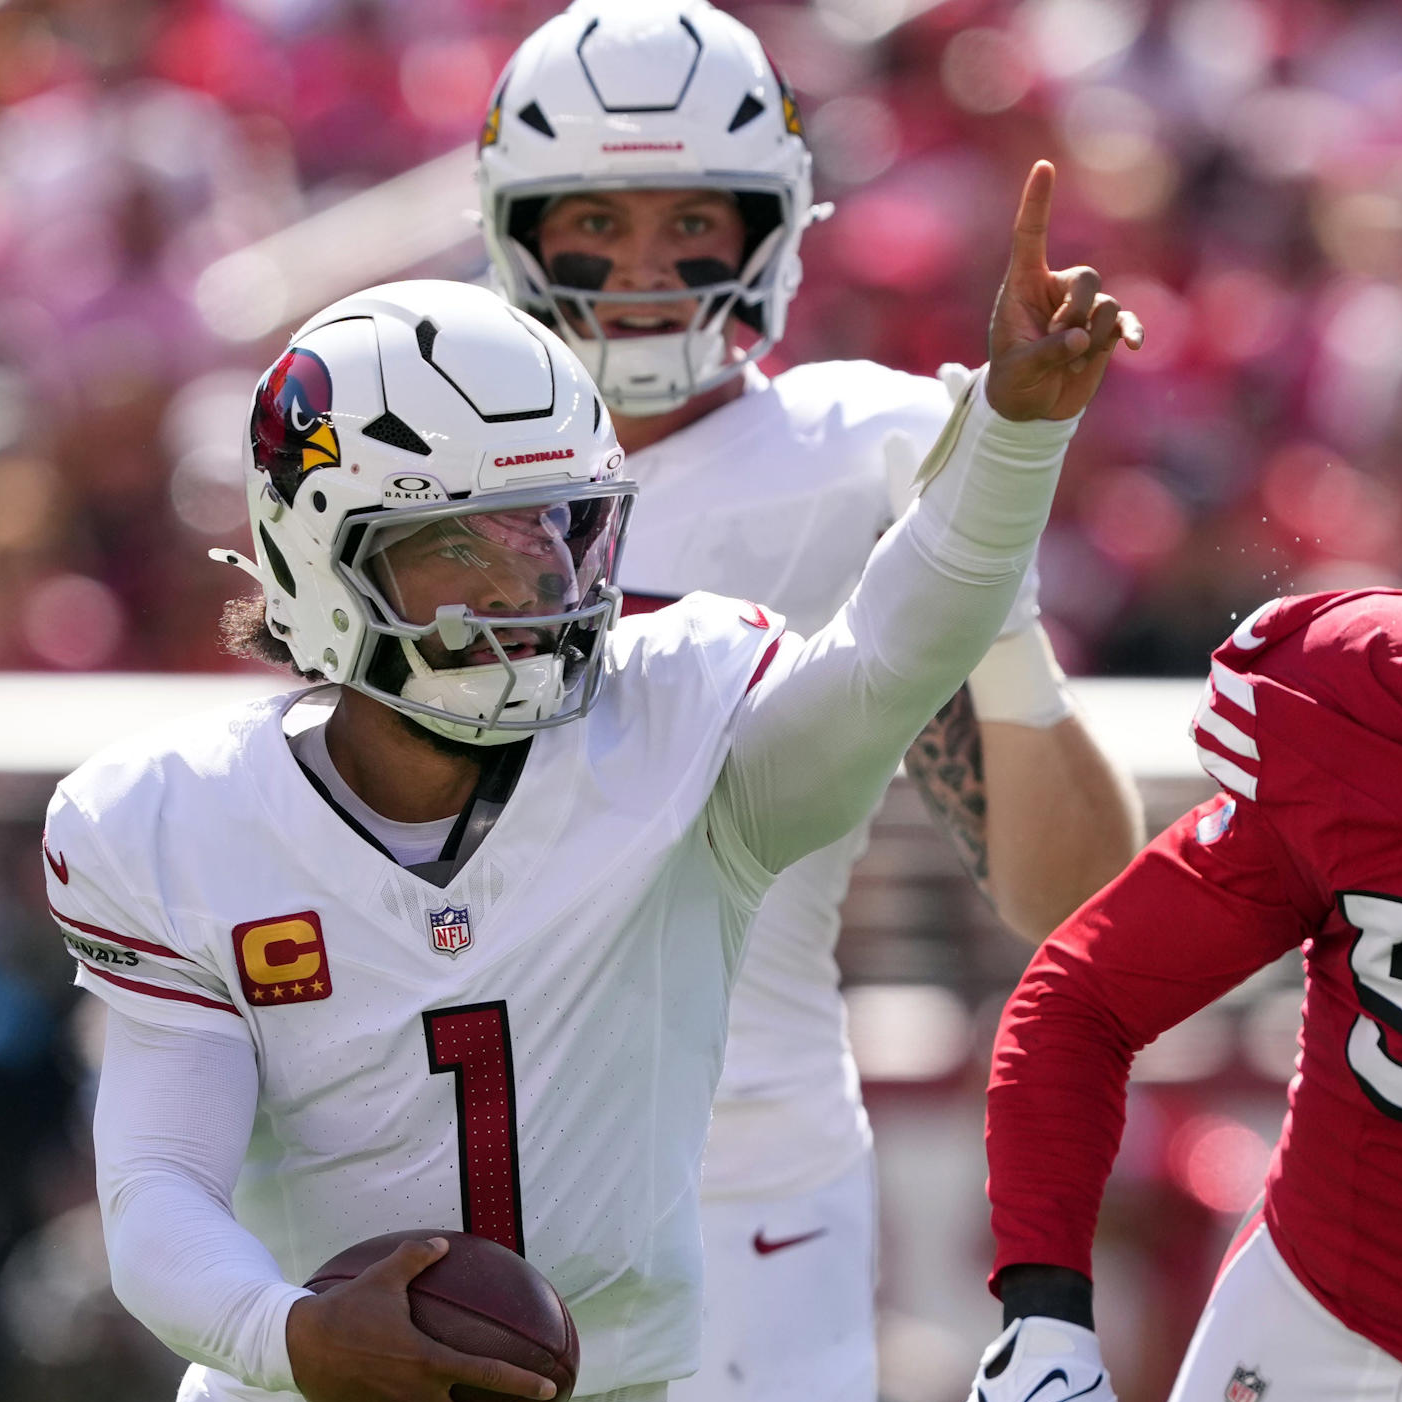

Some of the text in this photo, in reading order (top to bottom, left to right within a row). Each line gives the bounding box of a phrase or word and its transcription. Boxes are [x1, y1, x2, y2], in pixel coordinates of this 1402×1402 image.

[494, 449, 575, 467] CARDINALS
[384, 490, 441, 500] OAKLEY
[436, 925, 468, 948] NFL
[242, 919, 321, 985] C
[422, 999, 526, 1260] 1
